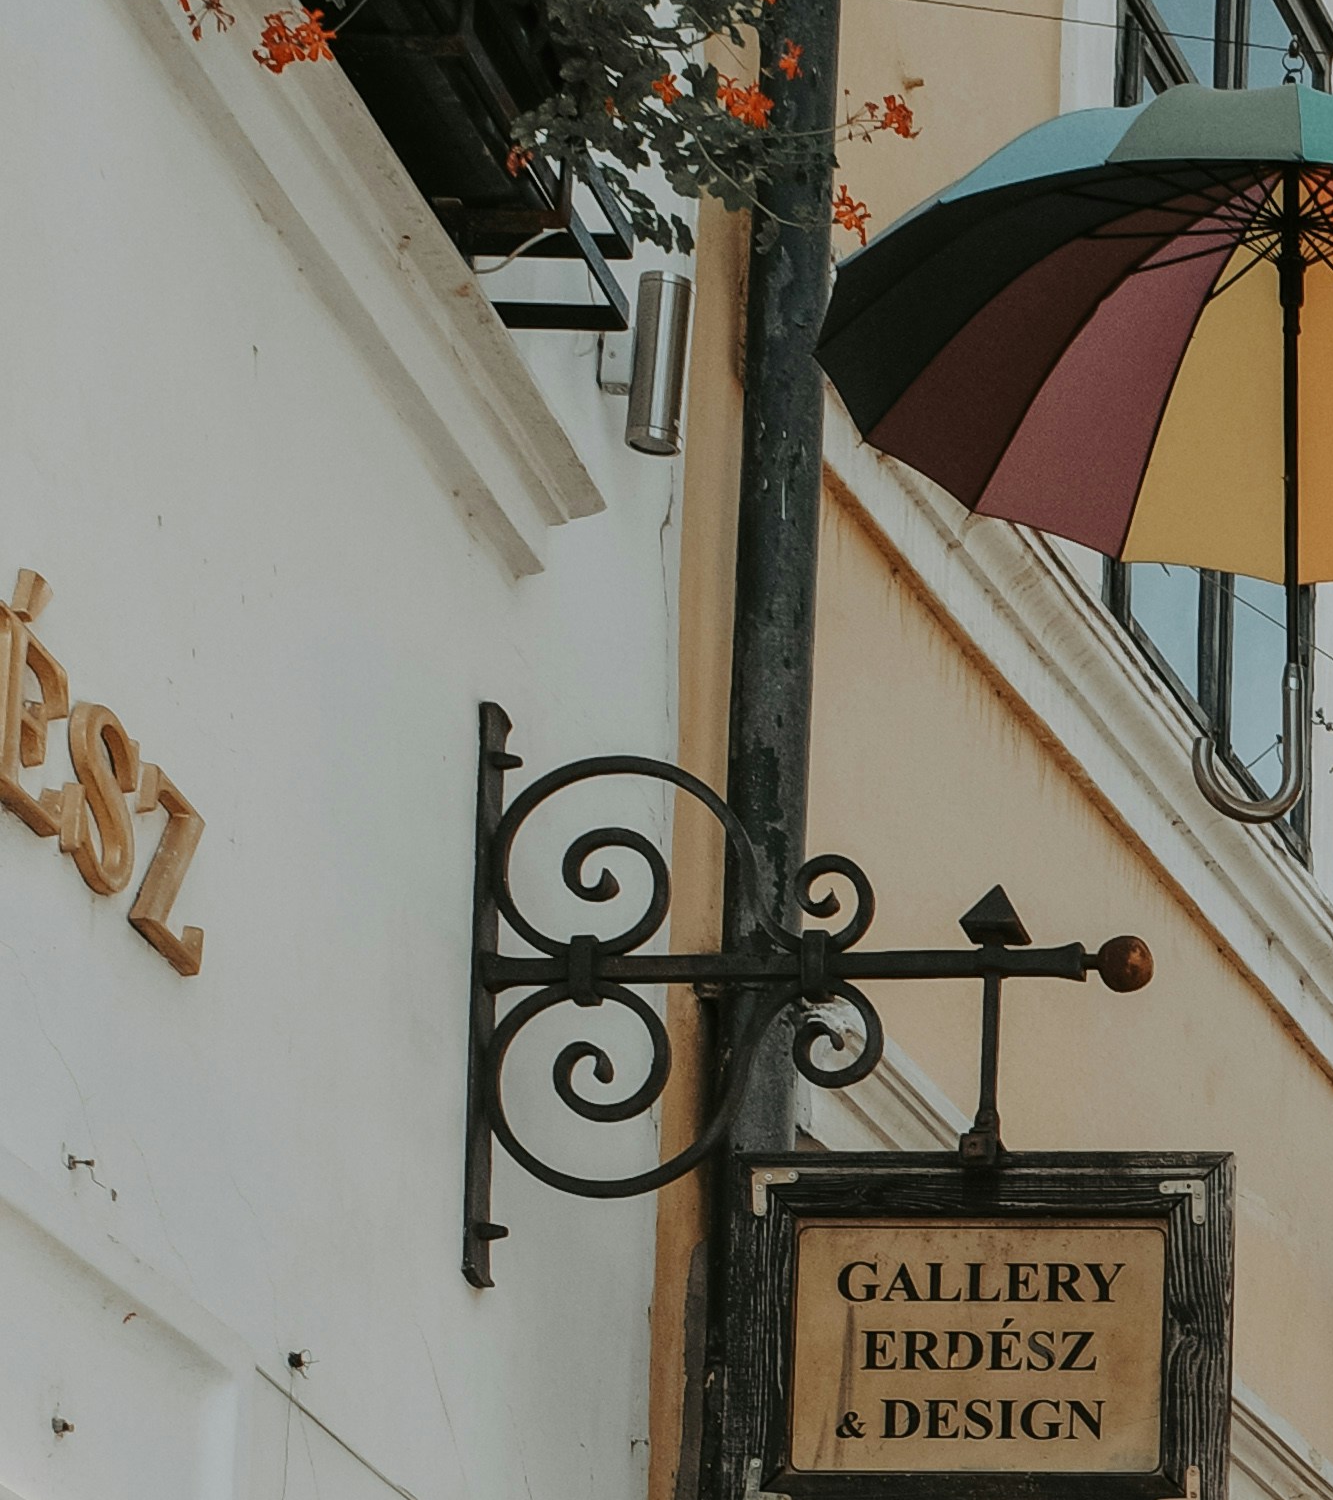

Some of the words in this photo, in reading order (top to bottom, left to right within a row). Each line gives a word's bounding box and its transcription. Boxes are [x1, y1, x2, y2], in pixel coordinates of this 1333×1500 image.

[836, 1260, 1126, 1304] GALLERY
[860, 1317, 1098, 1372] ERDÉSZ
[835, 1410, 866, 1439] &
[879, 1397, 1105, 1441] DESIGN
